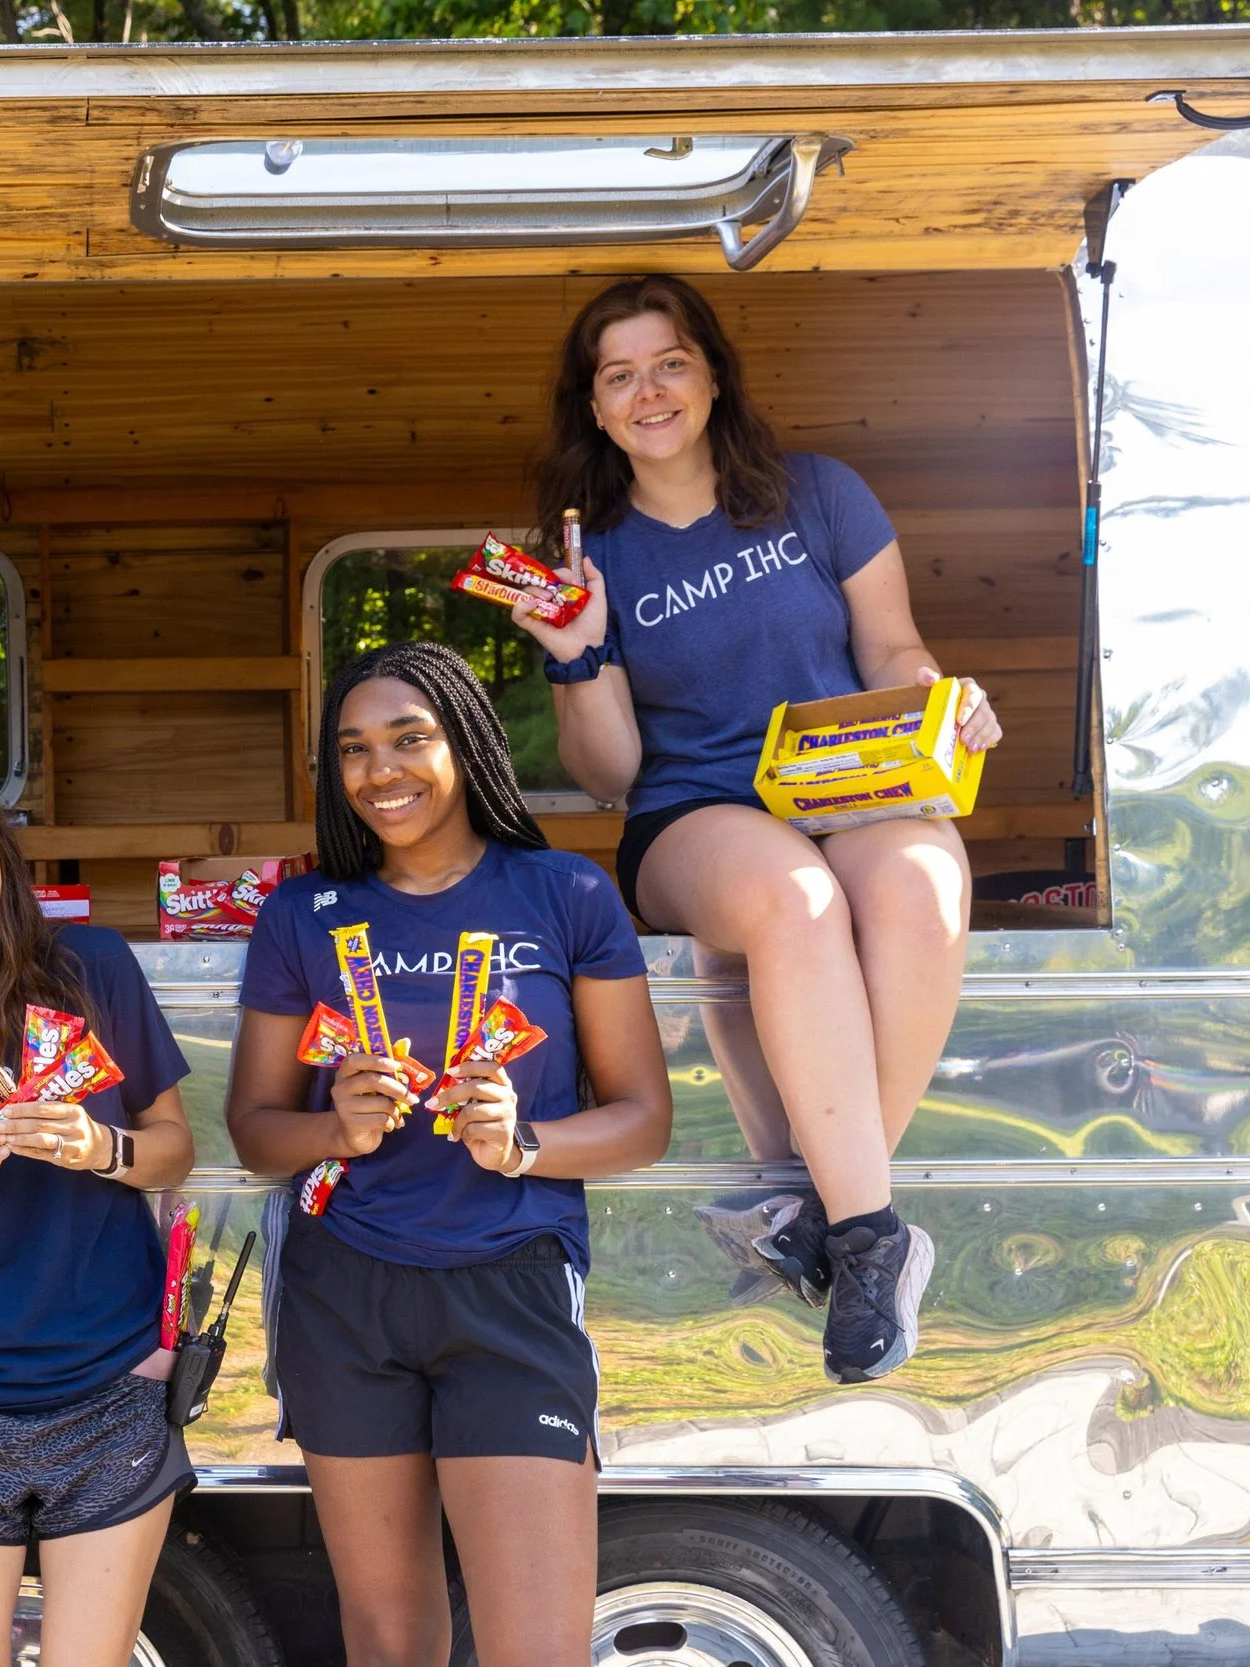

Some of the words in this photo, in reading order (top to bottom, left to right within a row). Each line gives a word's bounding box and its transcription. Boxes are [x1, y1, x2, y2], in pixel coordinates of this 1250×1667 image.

[635, 562, 734, 627] CAMP
[737, 531, 807, 583] IHC
[798, 726, 891, 752] CHARLESTON
[892, 720, 922, 737] CHE
[792, 791, 873, 812] CHARLESTON
[873, 781, 914, 800] CHEW
[166, 888, 217, 915] Skitt
[344, 955, 377, 1001] CHEW
[371, 951, 453, 977] AMP
[538, 1414, 579, 1436] adidas
